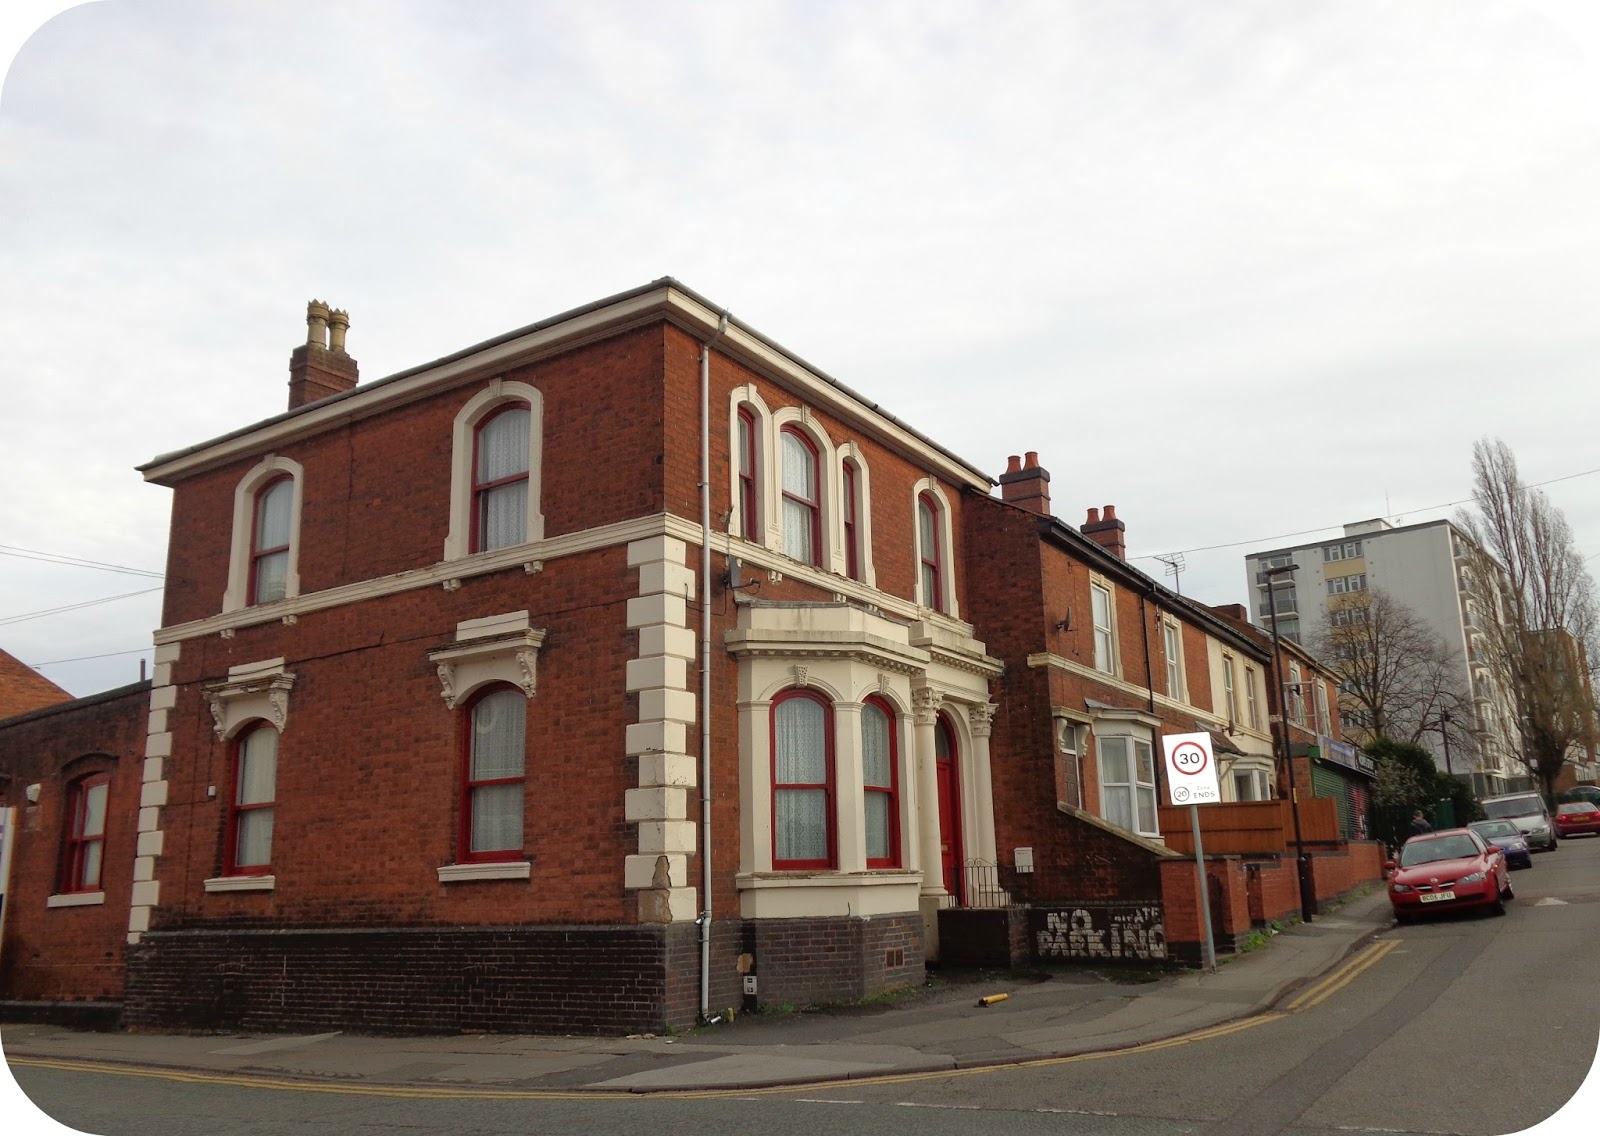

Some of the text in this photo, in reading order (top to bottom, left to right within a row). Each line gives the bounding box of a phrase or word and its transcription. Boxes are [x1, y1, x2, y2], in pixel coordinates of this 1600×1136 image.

[1180, 752, 1200, 765] 30
[1176, 790, 1188, 798] 20
[1193, 791, 1216, 799] ENDS
[1047, 908, 1092, 932] NO
[1037, 923, 1165, 959] PARKING
